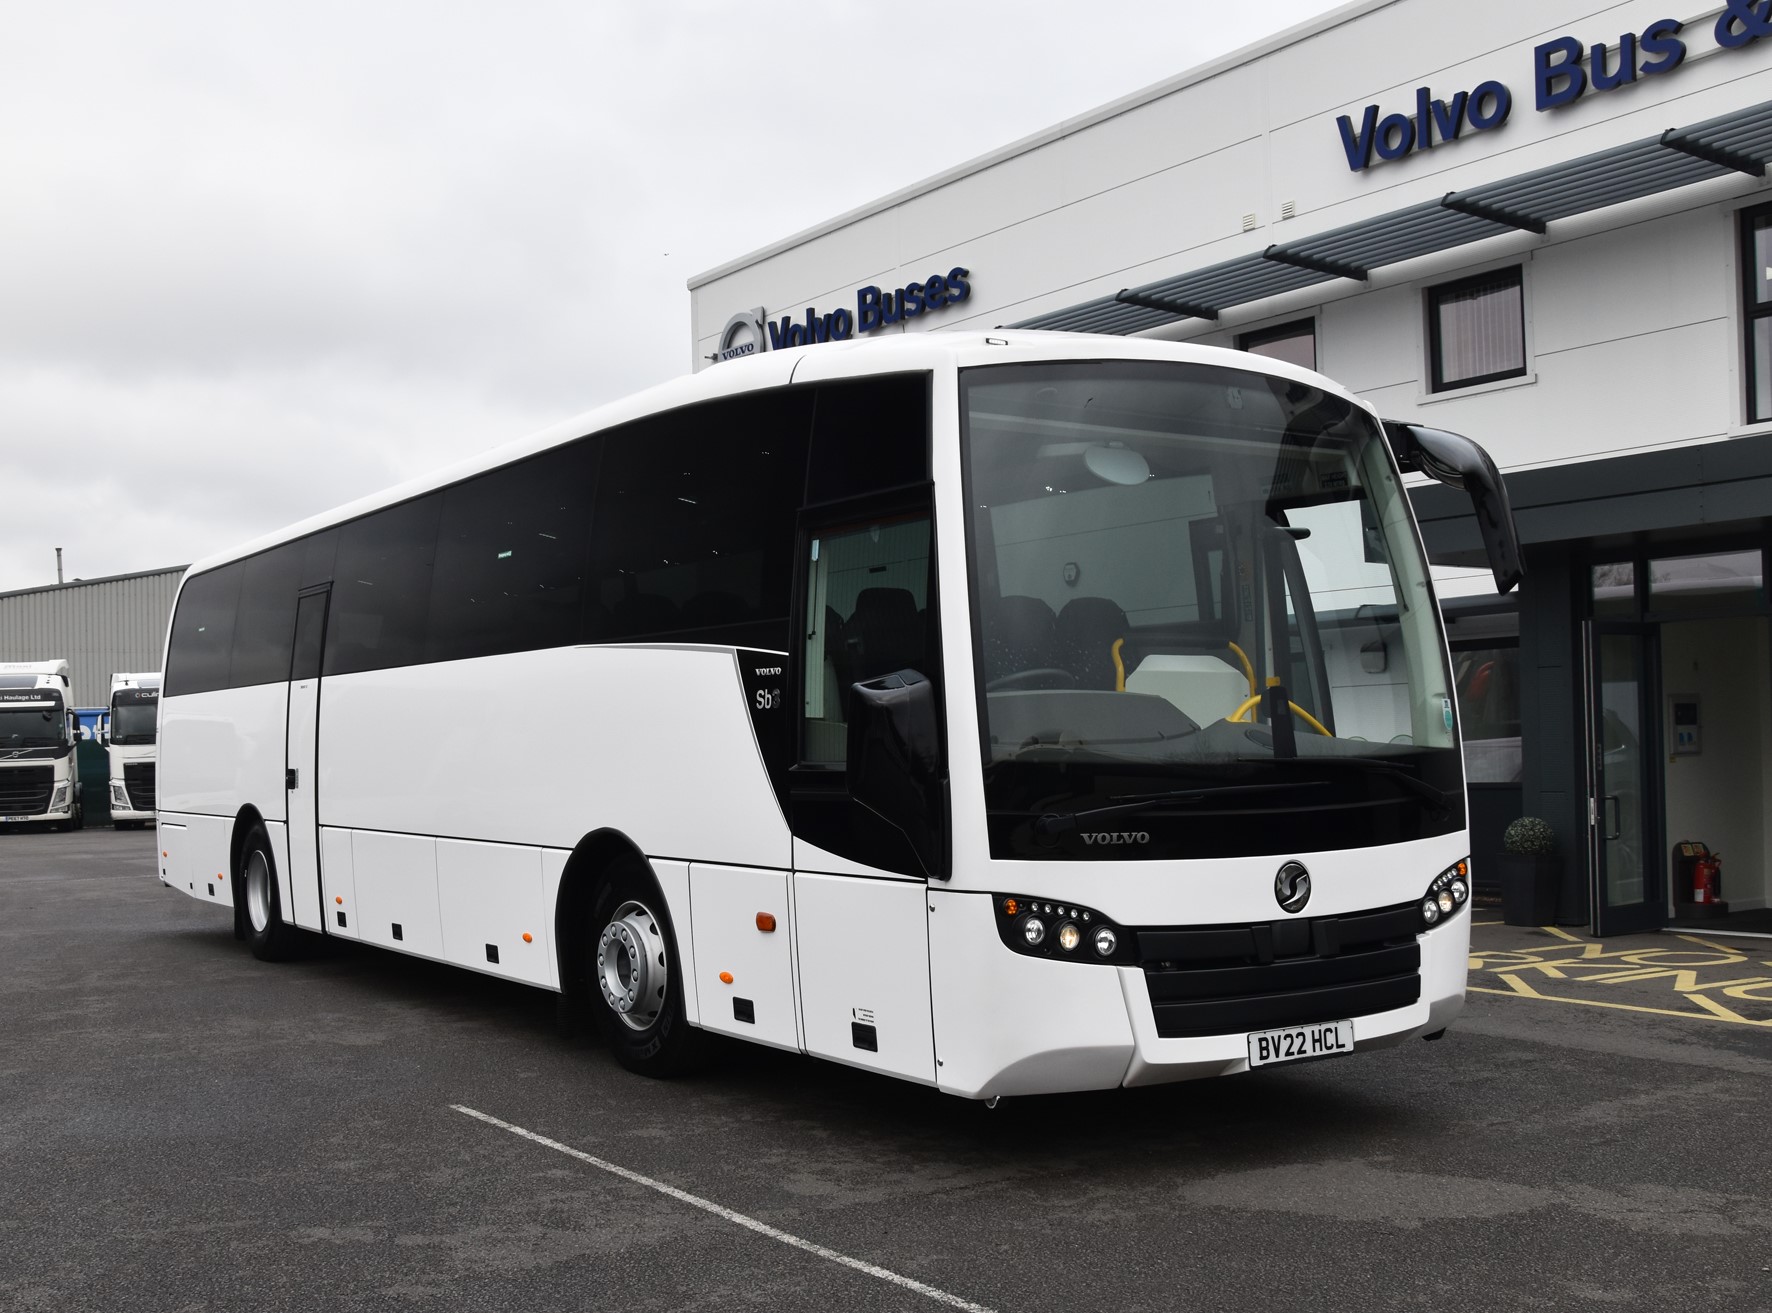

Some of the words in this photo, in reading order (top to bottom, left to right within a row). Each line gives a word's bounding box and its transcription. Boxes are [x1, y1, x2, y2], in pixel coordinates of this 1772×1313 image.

[1336, 80, 1512, 172] Volvo
[1534, 18, 1687, 112] Bus
[1714, 0, 1772, 49] &
[768, 307, 853, 350] Volvo
[857, 266, 971, 333] Buses
[722, 343, 754, 361] VOLVO
[755, 667, 782, 676] VOLVO
[756, 688, 780, 709] Sb3
[1080, 832, 1149, 845] VOLVO
[1511, 942, 1748, 967] NO
[1258, 1031, 1307, 1061] BV22
[1311, 1026, 1346, 1053] HCL
